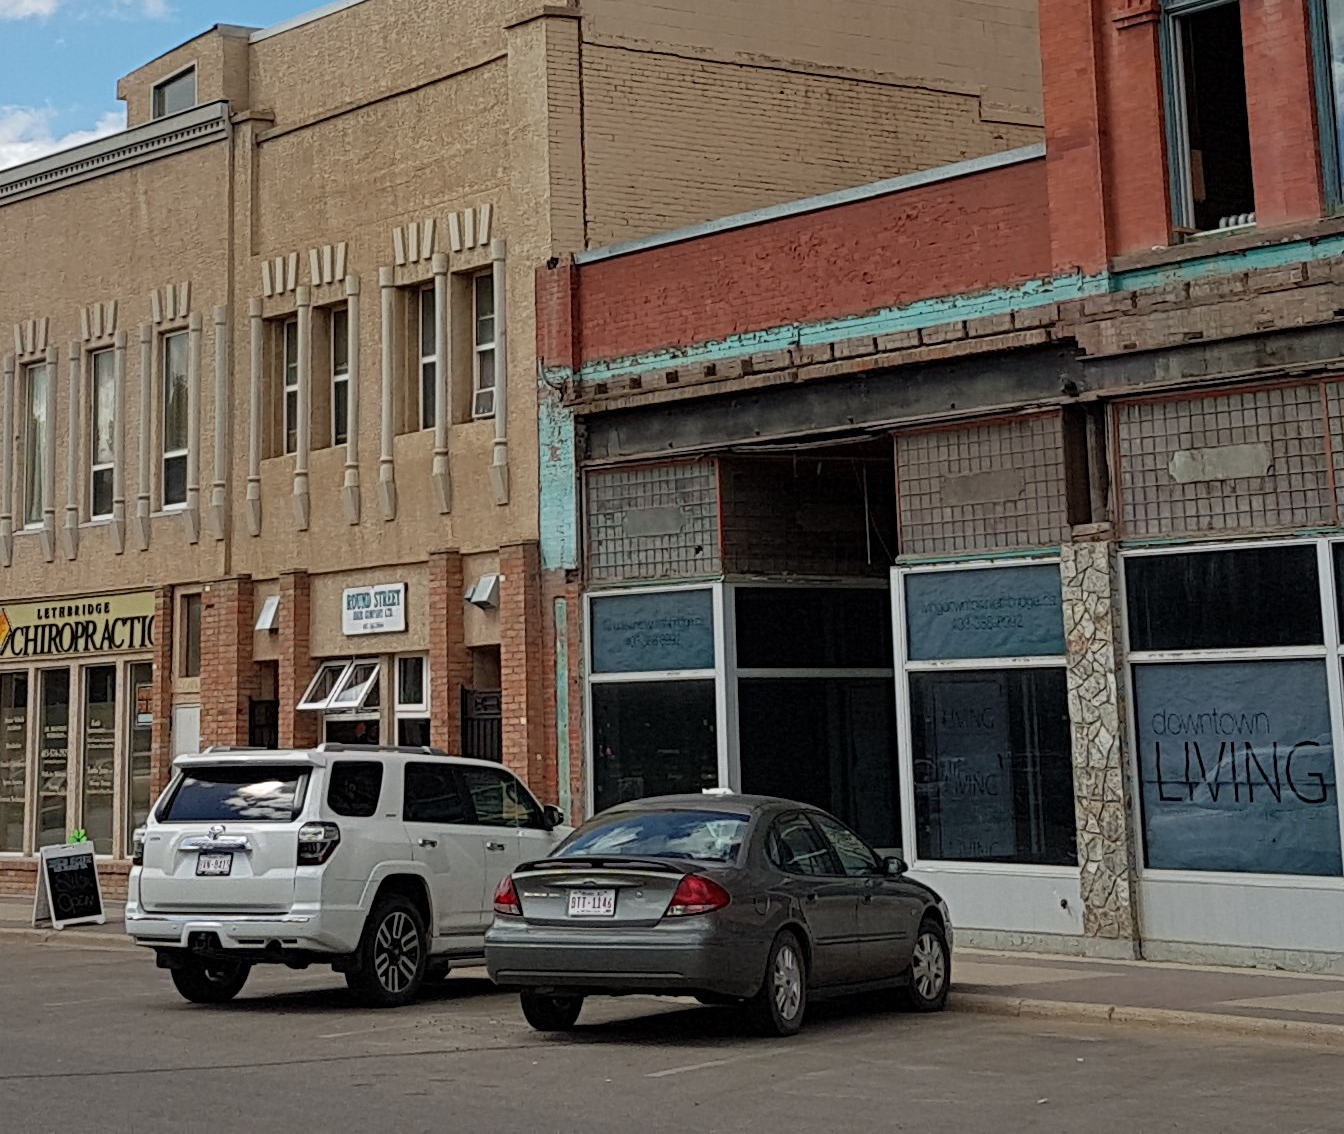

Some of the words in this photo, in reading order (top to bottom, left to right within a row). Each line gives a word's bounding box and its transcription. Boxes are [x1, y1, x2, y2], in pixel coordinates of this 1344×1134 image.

[37, 602, 110, 620] LETHBRIDGE
[346, 592, 371, 611] ROUND
[373, 589, 401, 608] STREET
[1151, 708, 1270, 736] downtown
[1155, 740, 1328, 804] LIVING
